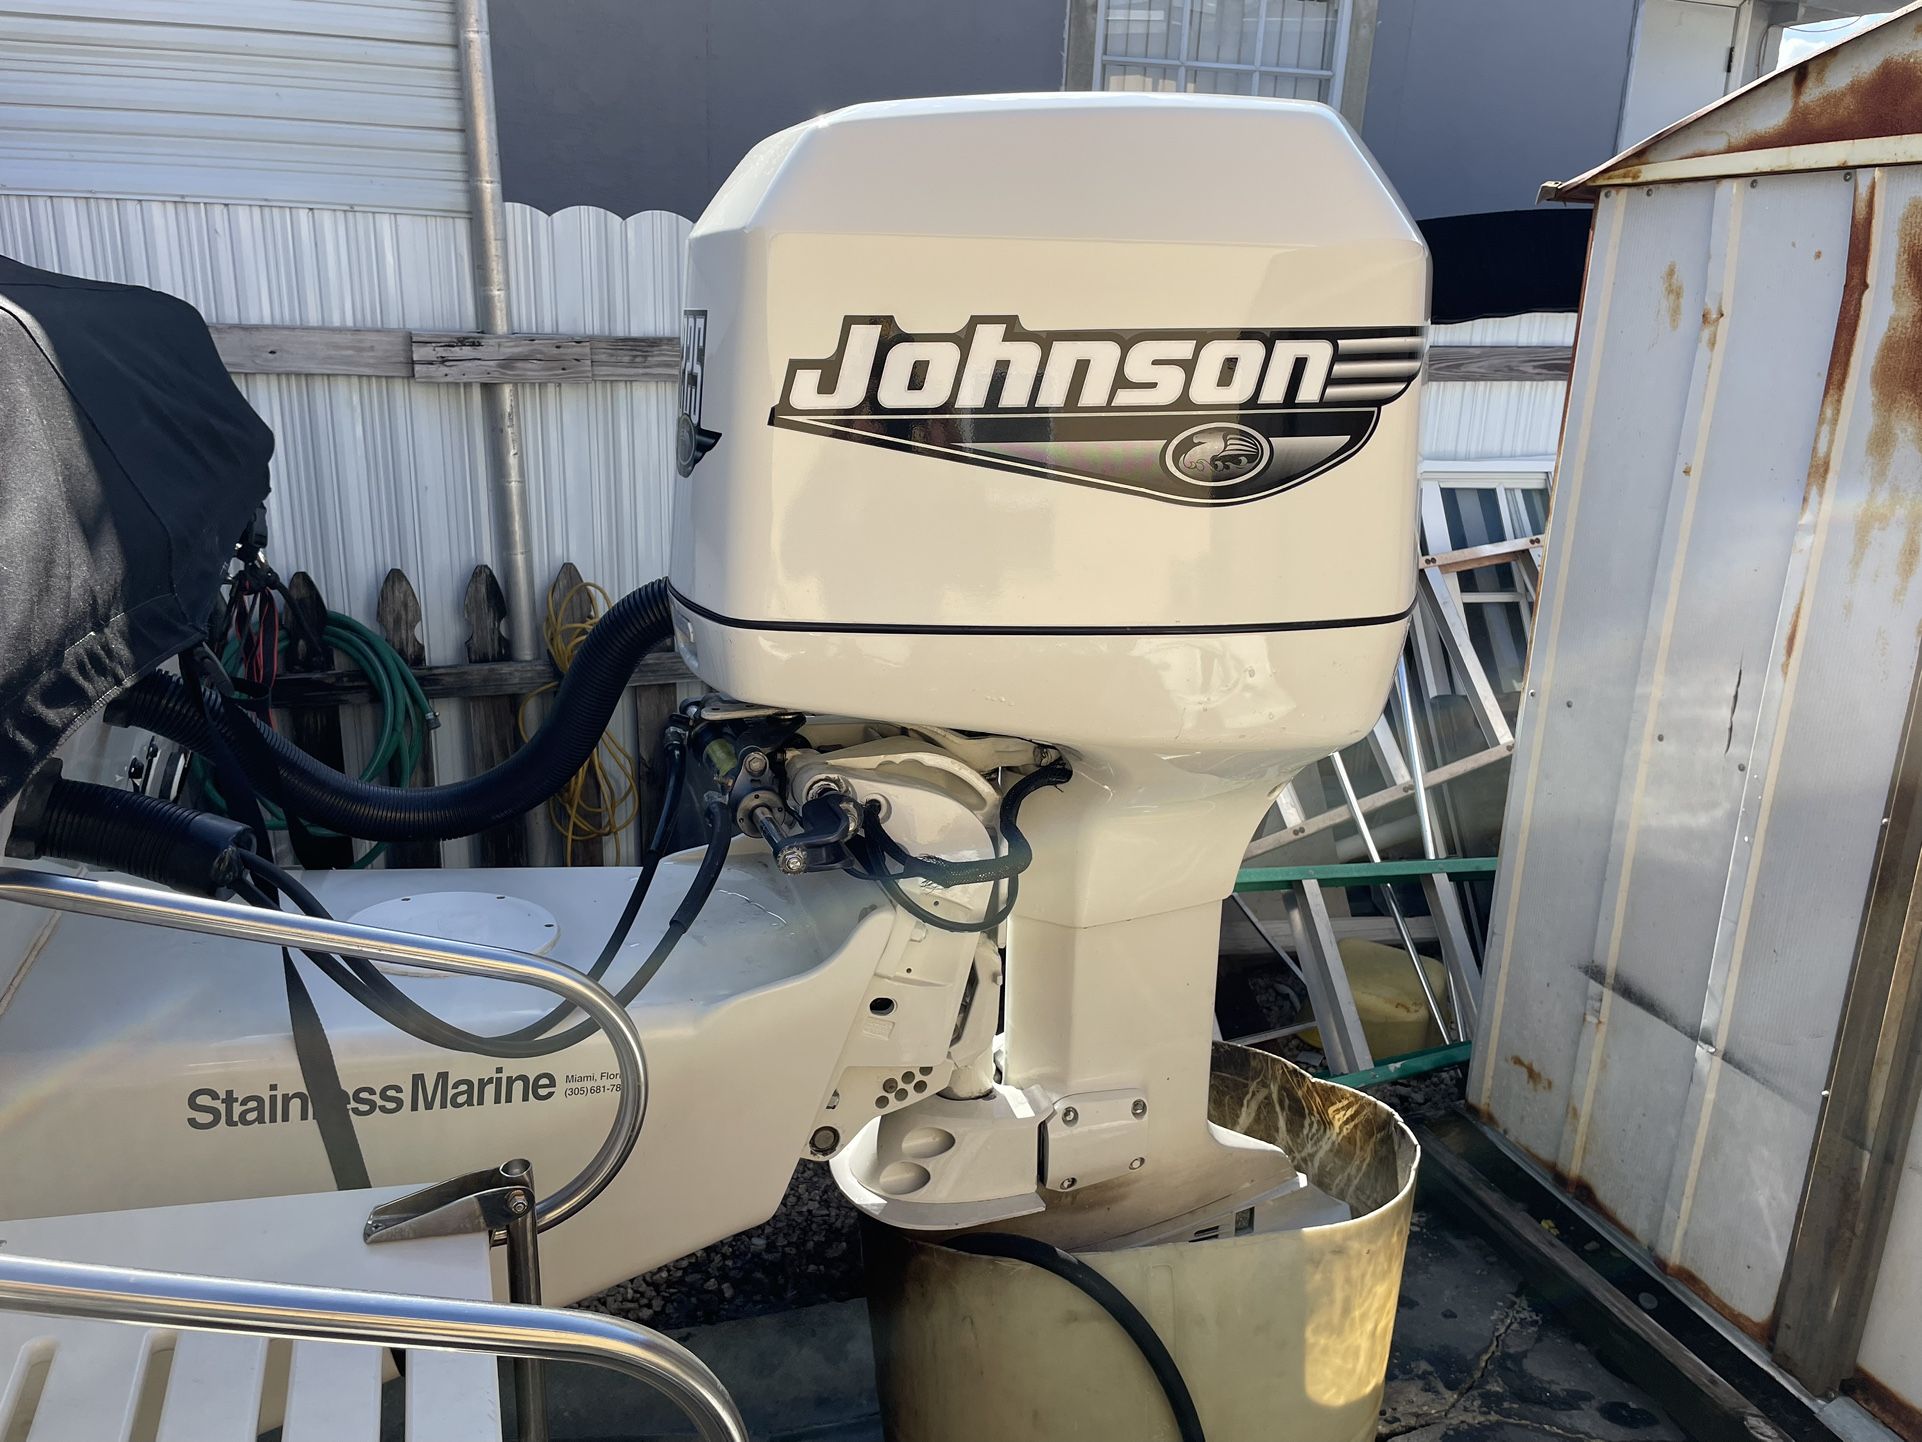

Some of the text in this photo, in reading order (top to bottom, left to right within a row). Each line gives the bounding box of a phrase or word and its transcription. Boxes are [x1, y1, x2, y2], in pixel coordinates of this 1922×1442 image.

[789, 324, 1335, 408] Johnson
[564, 1086, 588, 1098] (305)
[565, 1073, 597, 1083] Miami,
[187, 1067, 556, 1130] Stainss Marine
